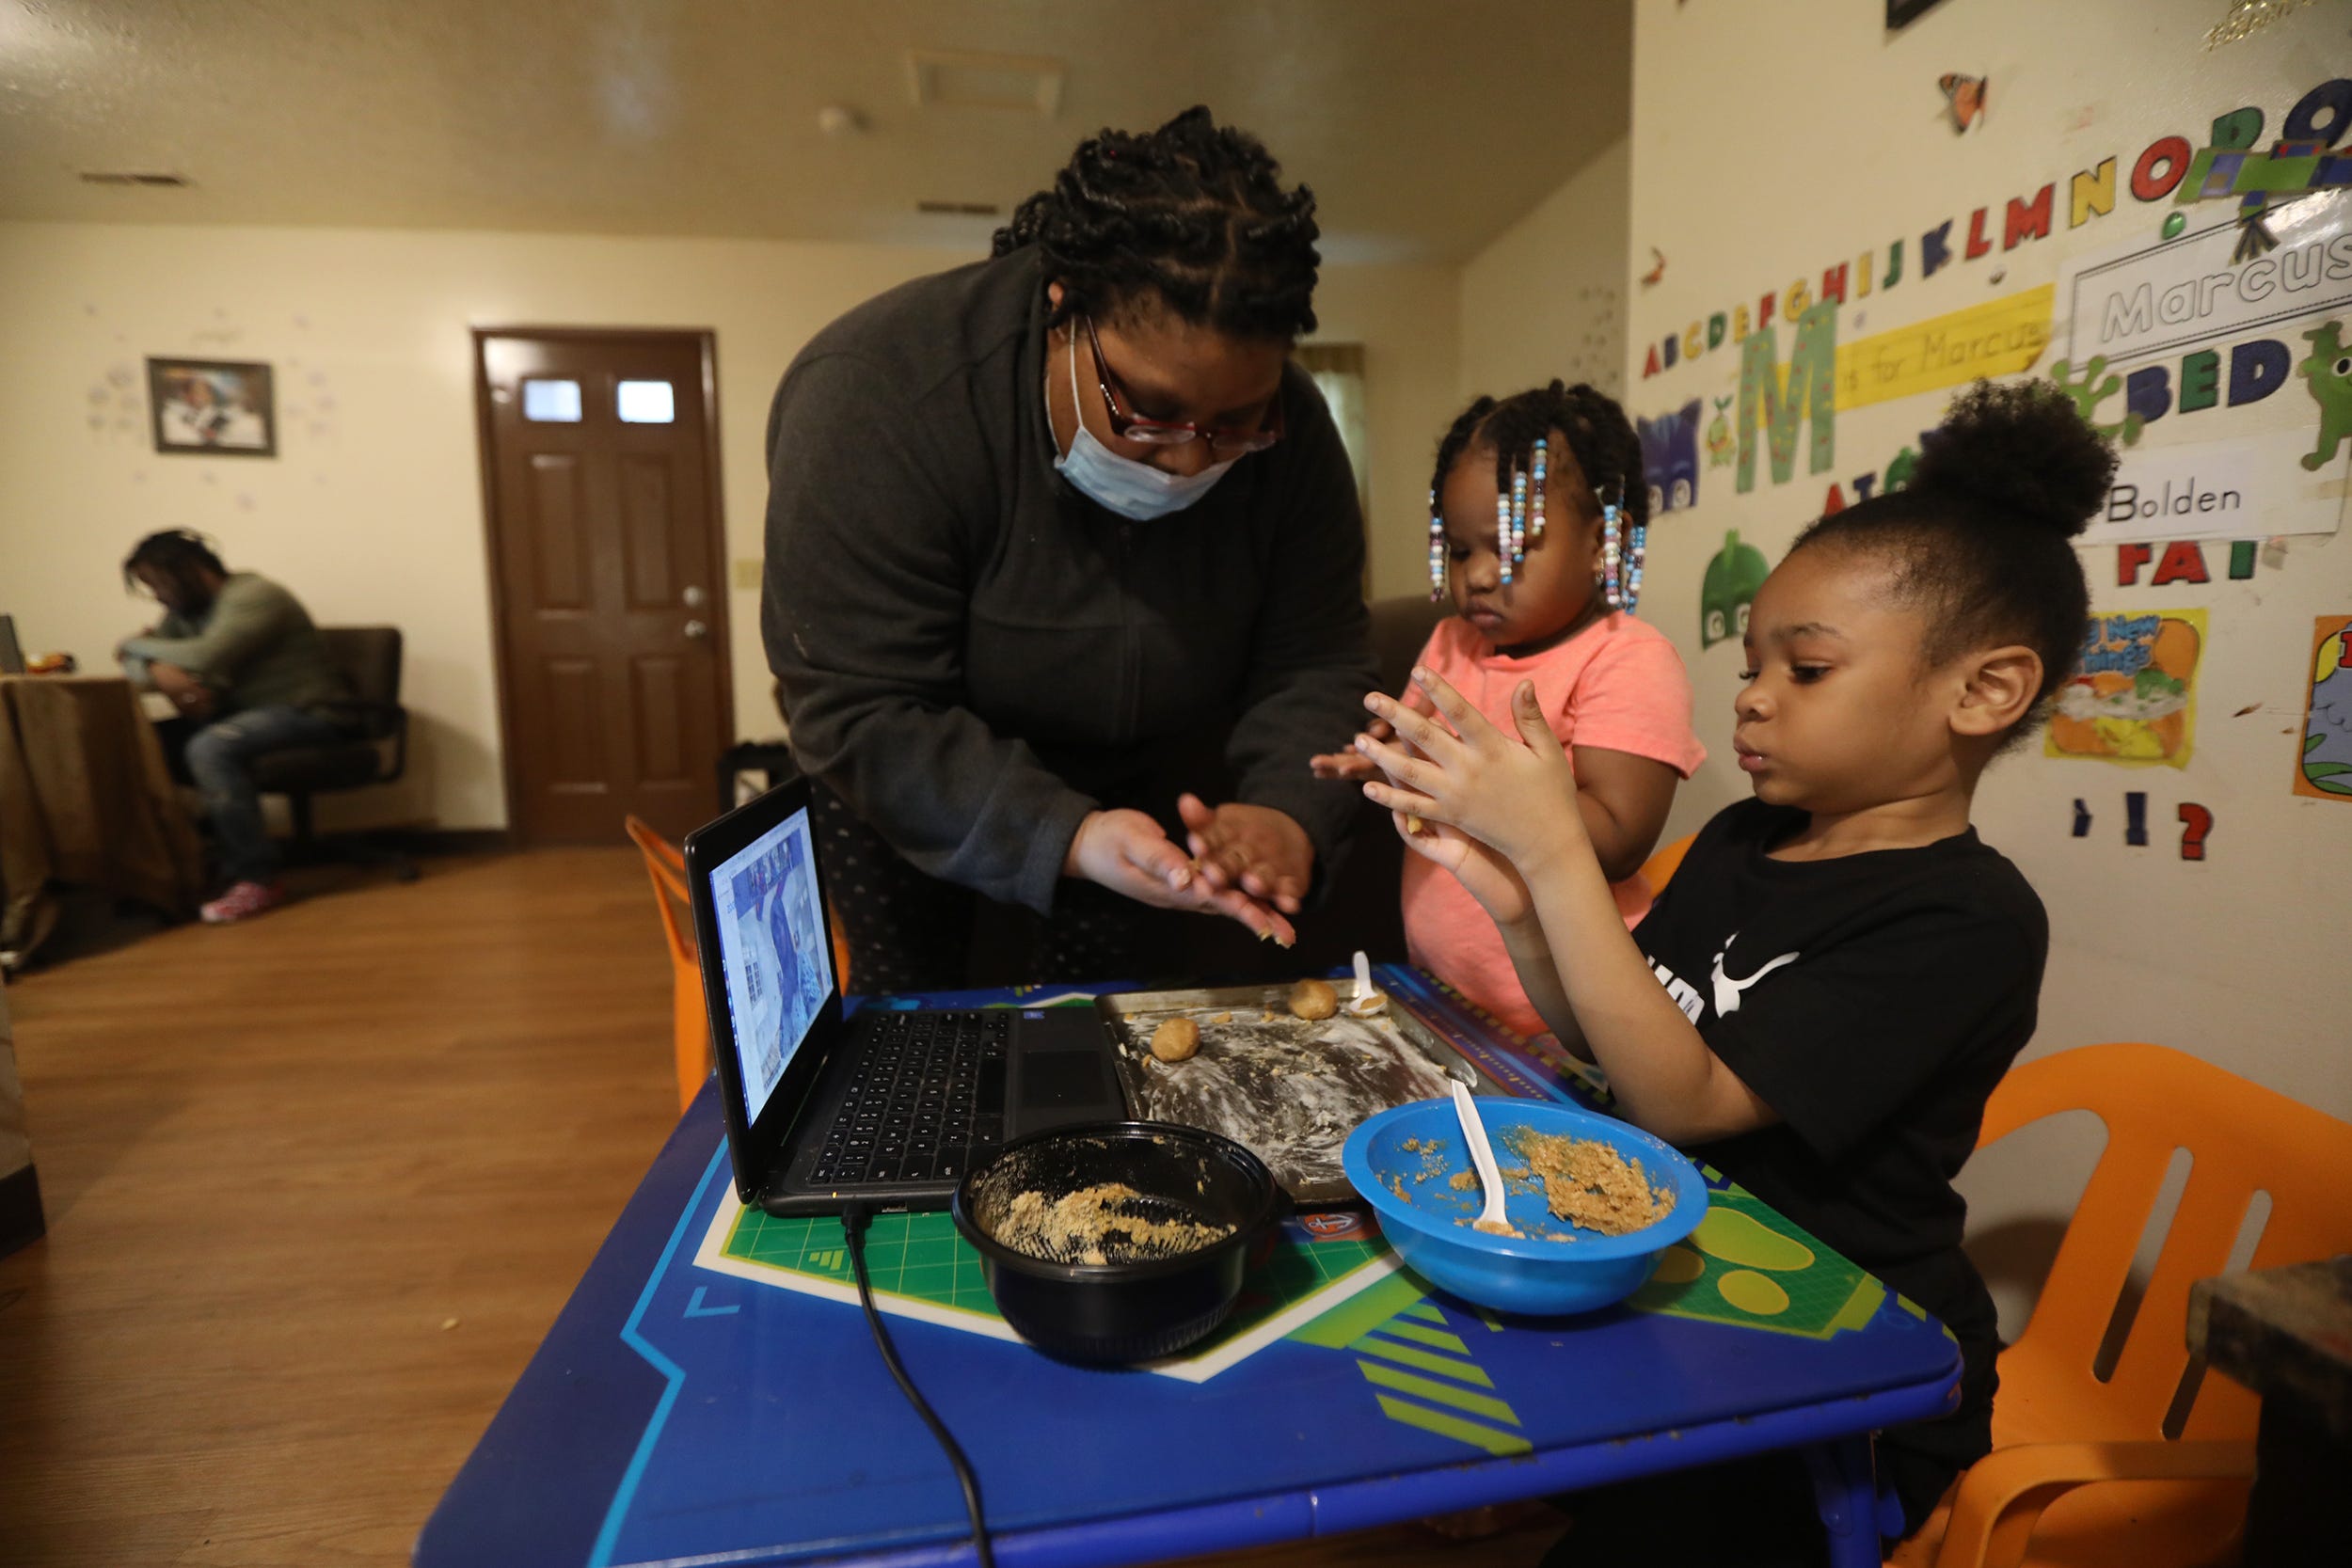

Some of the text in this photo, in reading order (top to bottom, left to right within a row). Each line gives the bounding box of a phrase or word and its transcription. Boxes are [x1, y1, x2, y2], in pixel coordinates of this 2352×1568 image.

[2102, 233, 2352, 342] Marcus
[1922, 321, 2043, 370] Marcus
[2126, 339, 2292, 425] BED
[2106, 476, 2241, 523] Bolden
